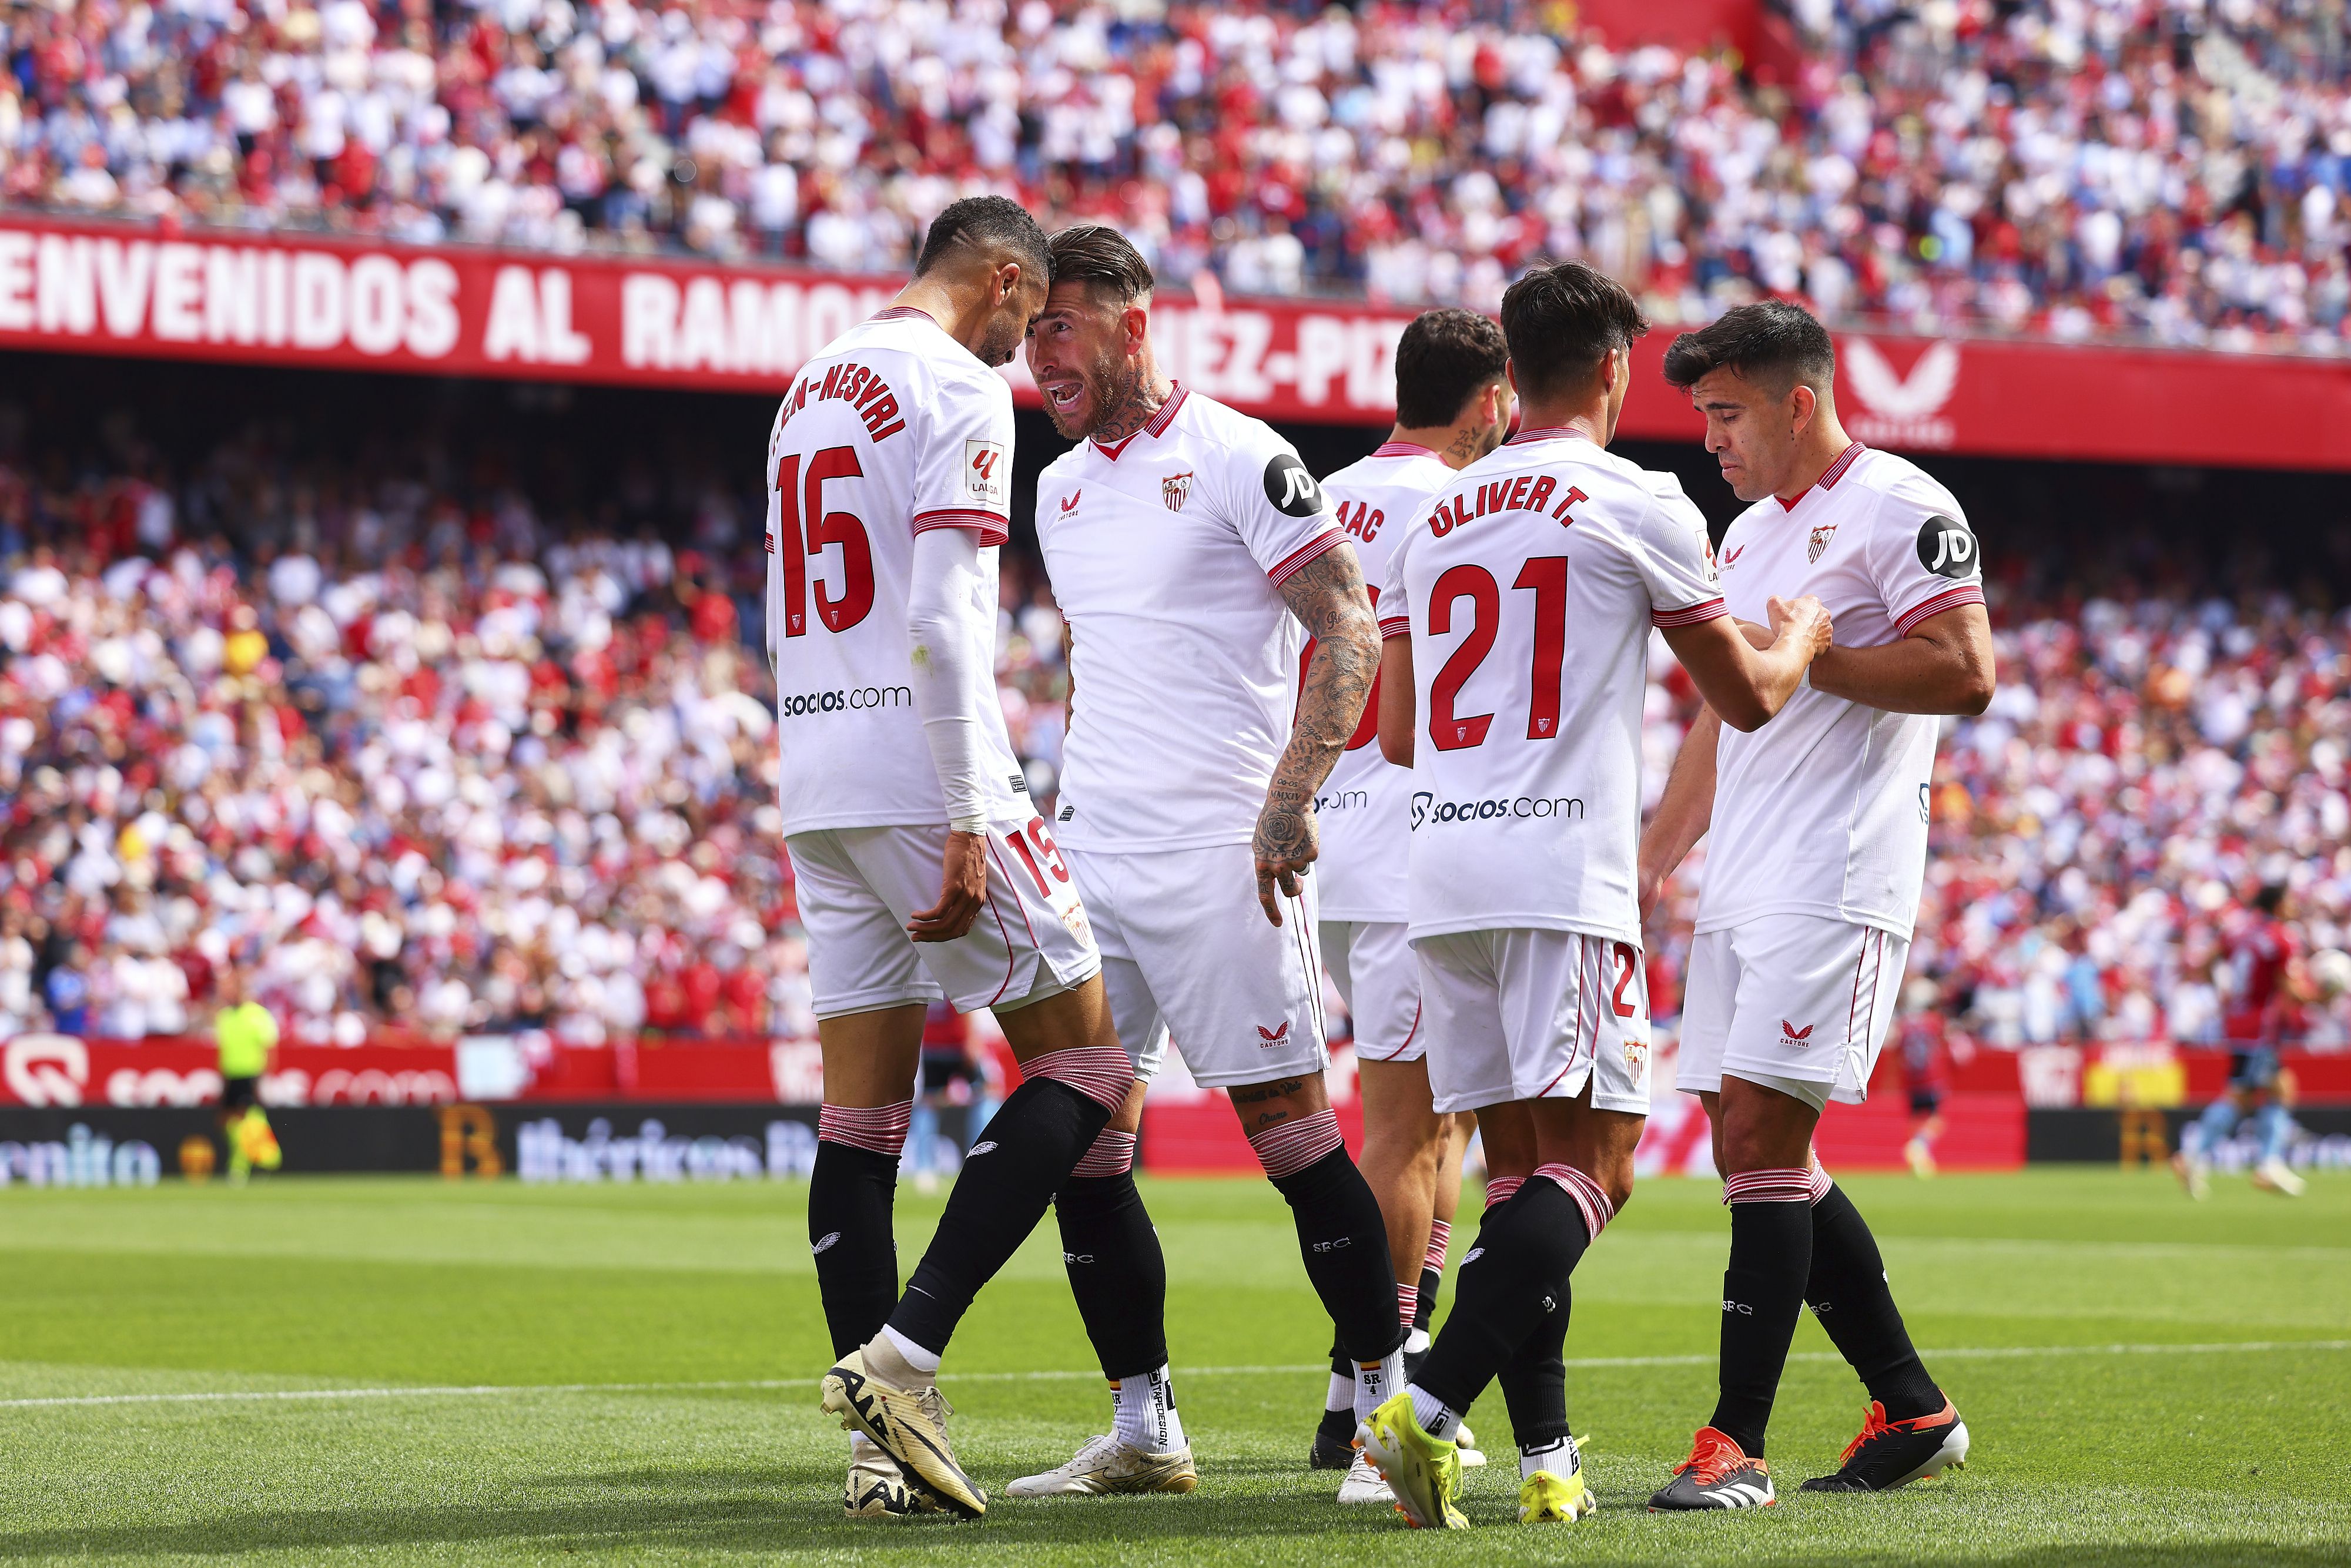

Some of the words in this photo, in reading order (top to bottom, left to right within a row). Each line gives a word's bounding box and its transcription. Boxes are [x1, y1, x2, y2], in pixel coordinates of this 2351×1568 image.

[482, 264, 591, 364] AL
[621, 273, 893, 382] RAMO
[1281, 467, 1316, 509] JD
[1428, 475, 1557, 538] ÓLIVER
[1552, 485, 1589, 528] T.
[1059, 510, 1079, 522] CASTORE
[775, 445, 875, 638] 15
[1931, 529, 1972, 571] JD
[1428, 555, 1569, 752] 21
[1005, 815, 1070, 899] 15
[1260, 1038, 1289, 1048] CASTORE
[1780, 1038, 1810, 1048] CASTORE
[1364, 1373, 1382, 1385] SR
[1369, 1385, 1377, 1395] 4
